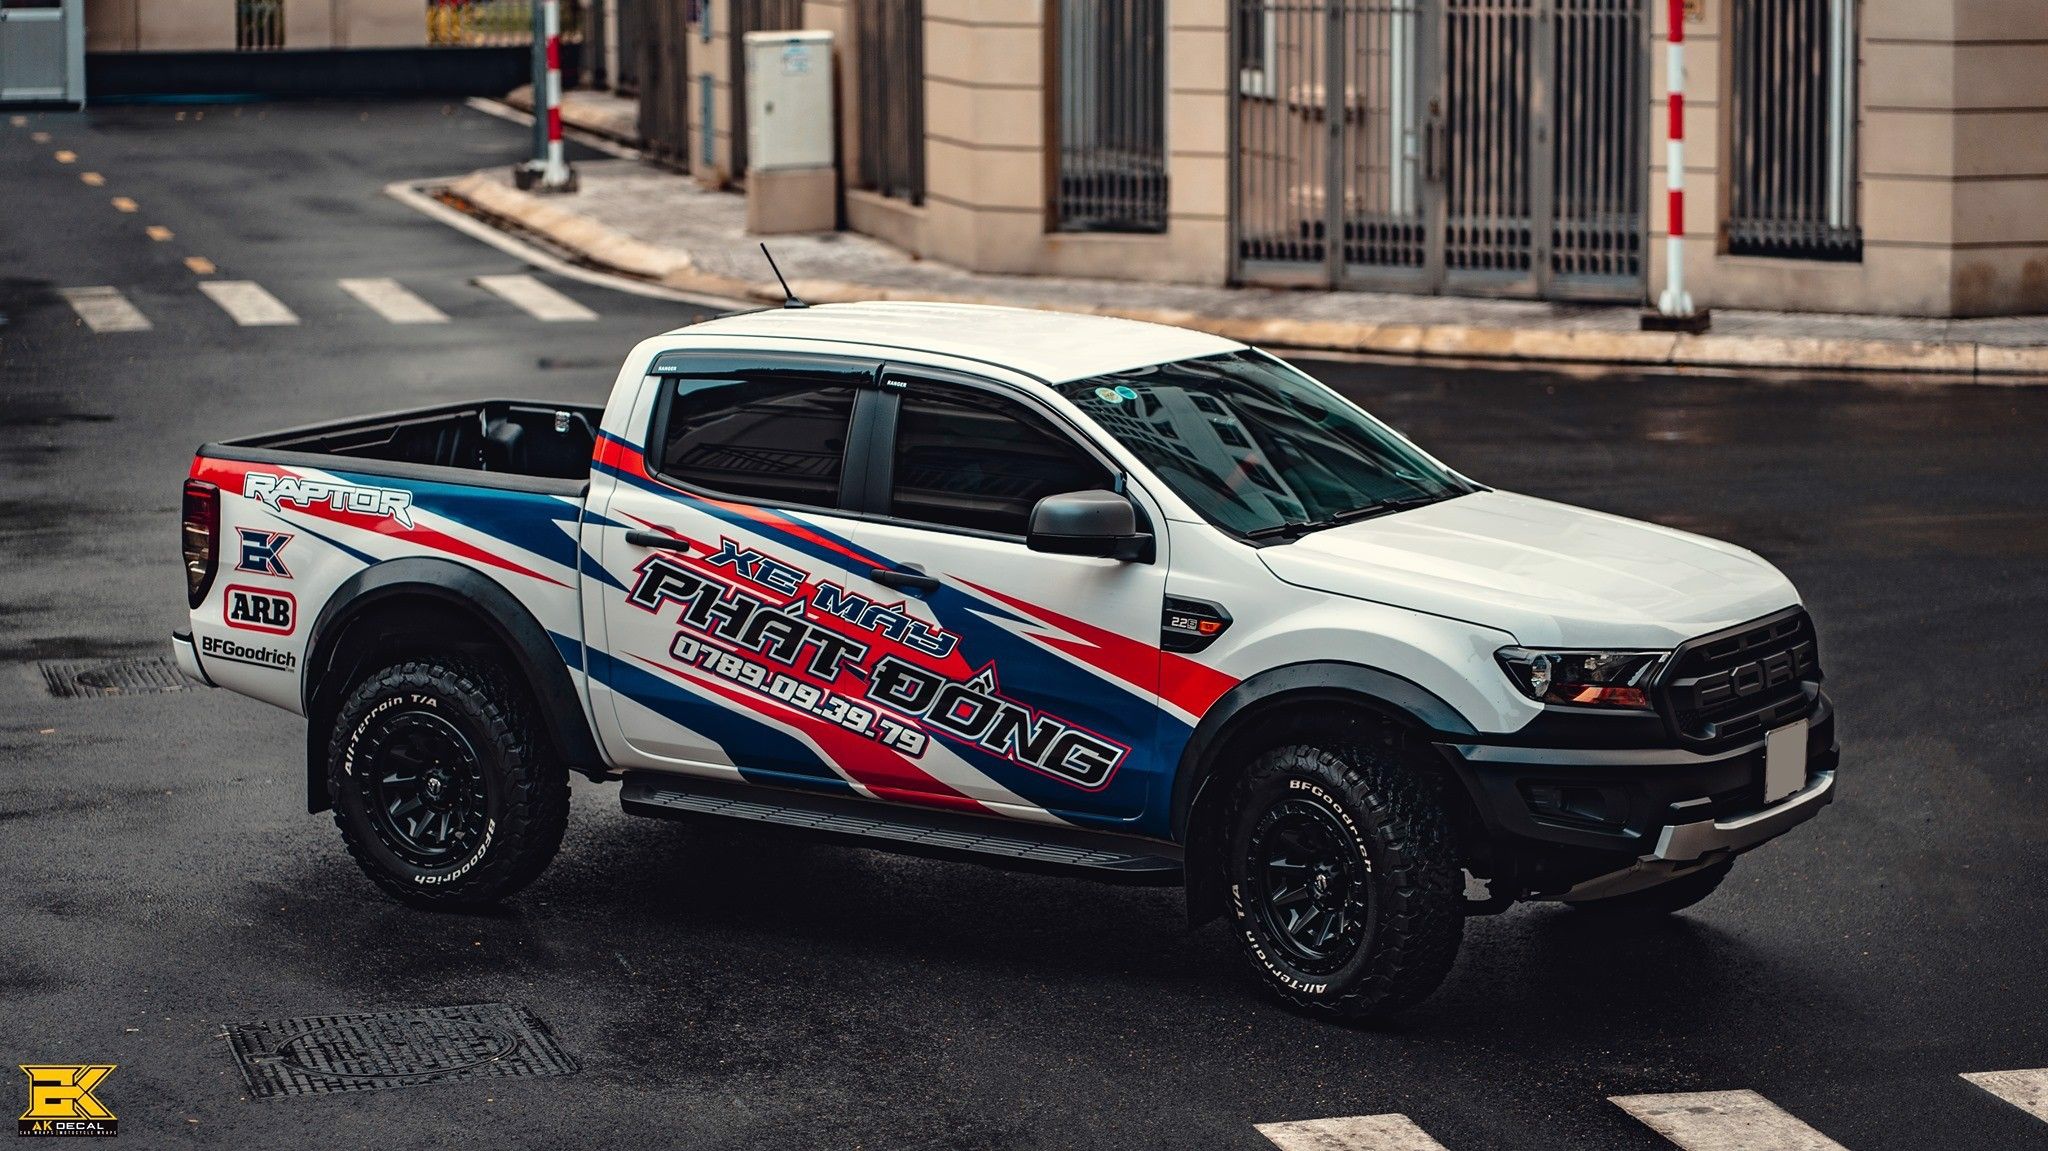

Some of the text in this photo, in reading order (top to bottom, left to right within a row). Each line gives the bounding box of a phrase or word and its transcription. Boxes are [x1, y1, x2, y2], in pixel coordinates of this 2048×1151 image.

[244, 472, 414, 530] RAPTOR
[231, 593, 290, 627] ARB
[631, 558, 868, 682] PHÁT
[706, 538, 958, 658] XE MÁY
[202, 636, 296, 667] BFGoodrich
[674, 635, 927, 754] 0789.09.39.79
[343, 694, 437, 776] All-Terrain T/A
[414, 818, 496, 885] BFGoodrich
[1289, 779, 1373, 873] BFGoodrich
[1246, 930, 1327, 994] All-Terrain
